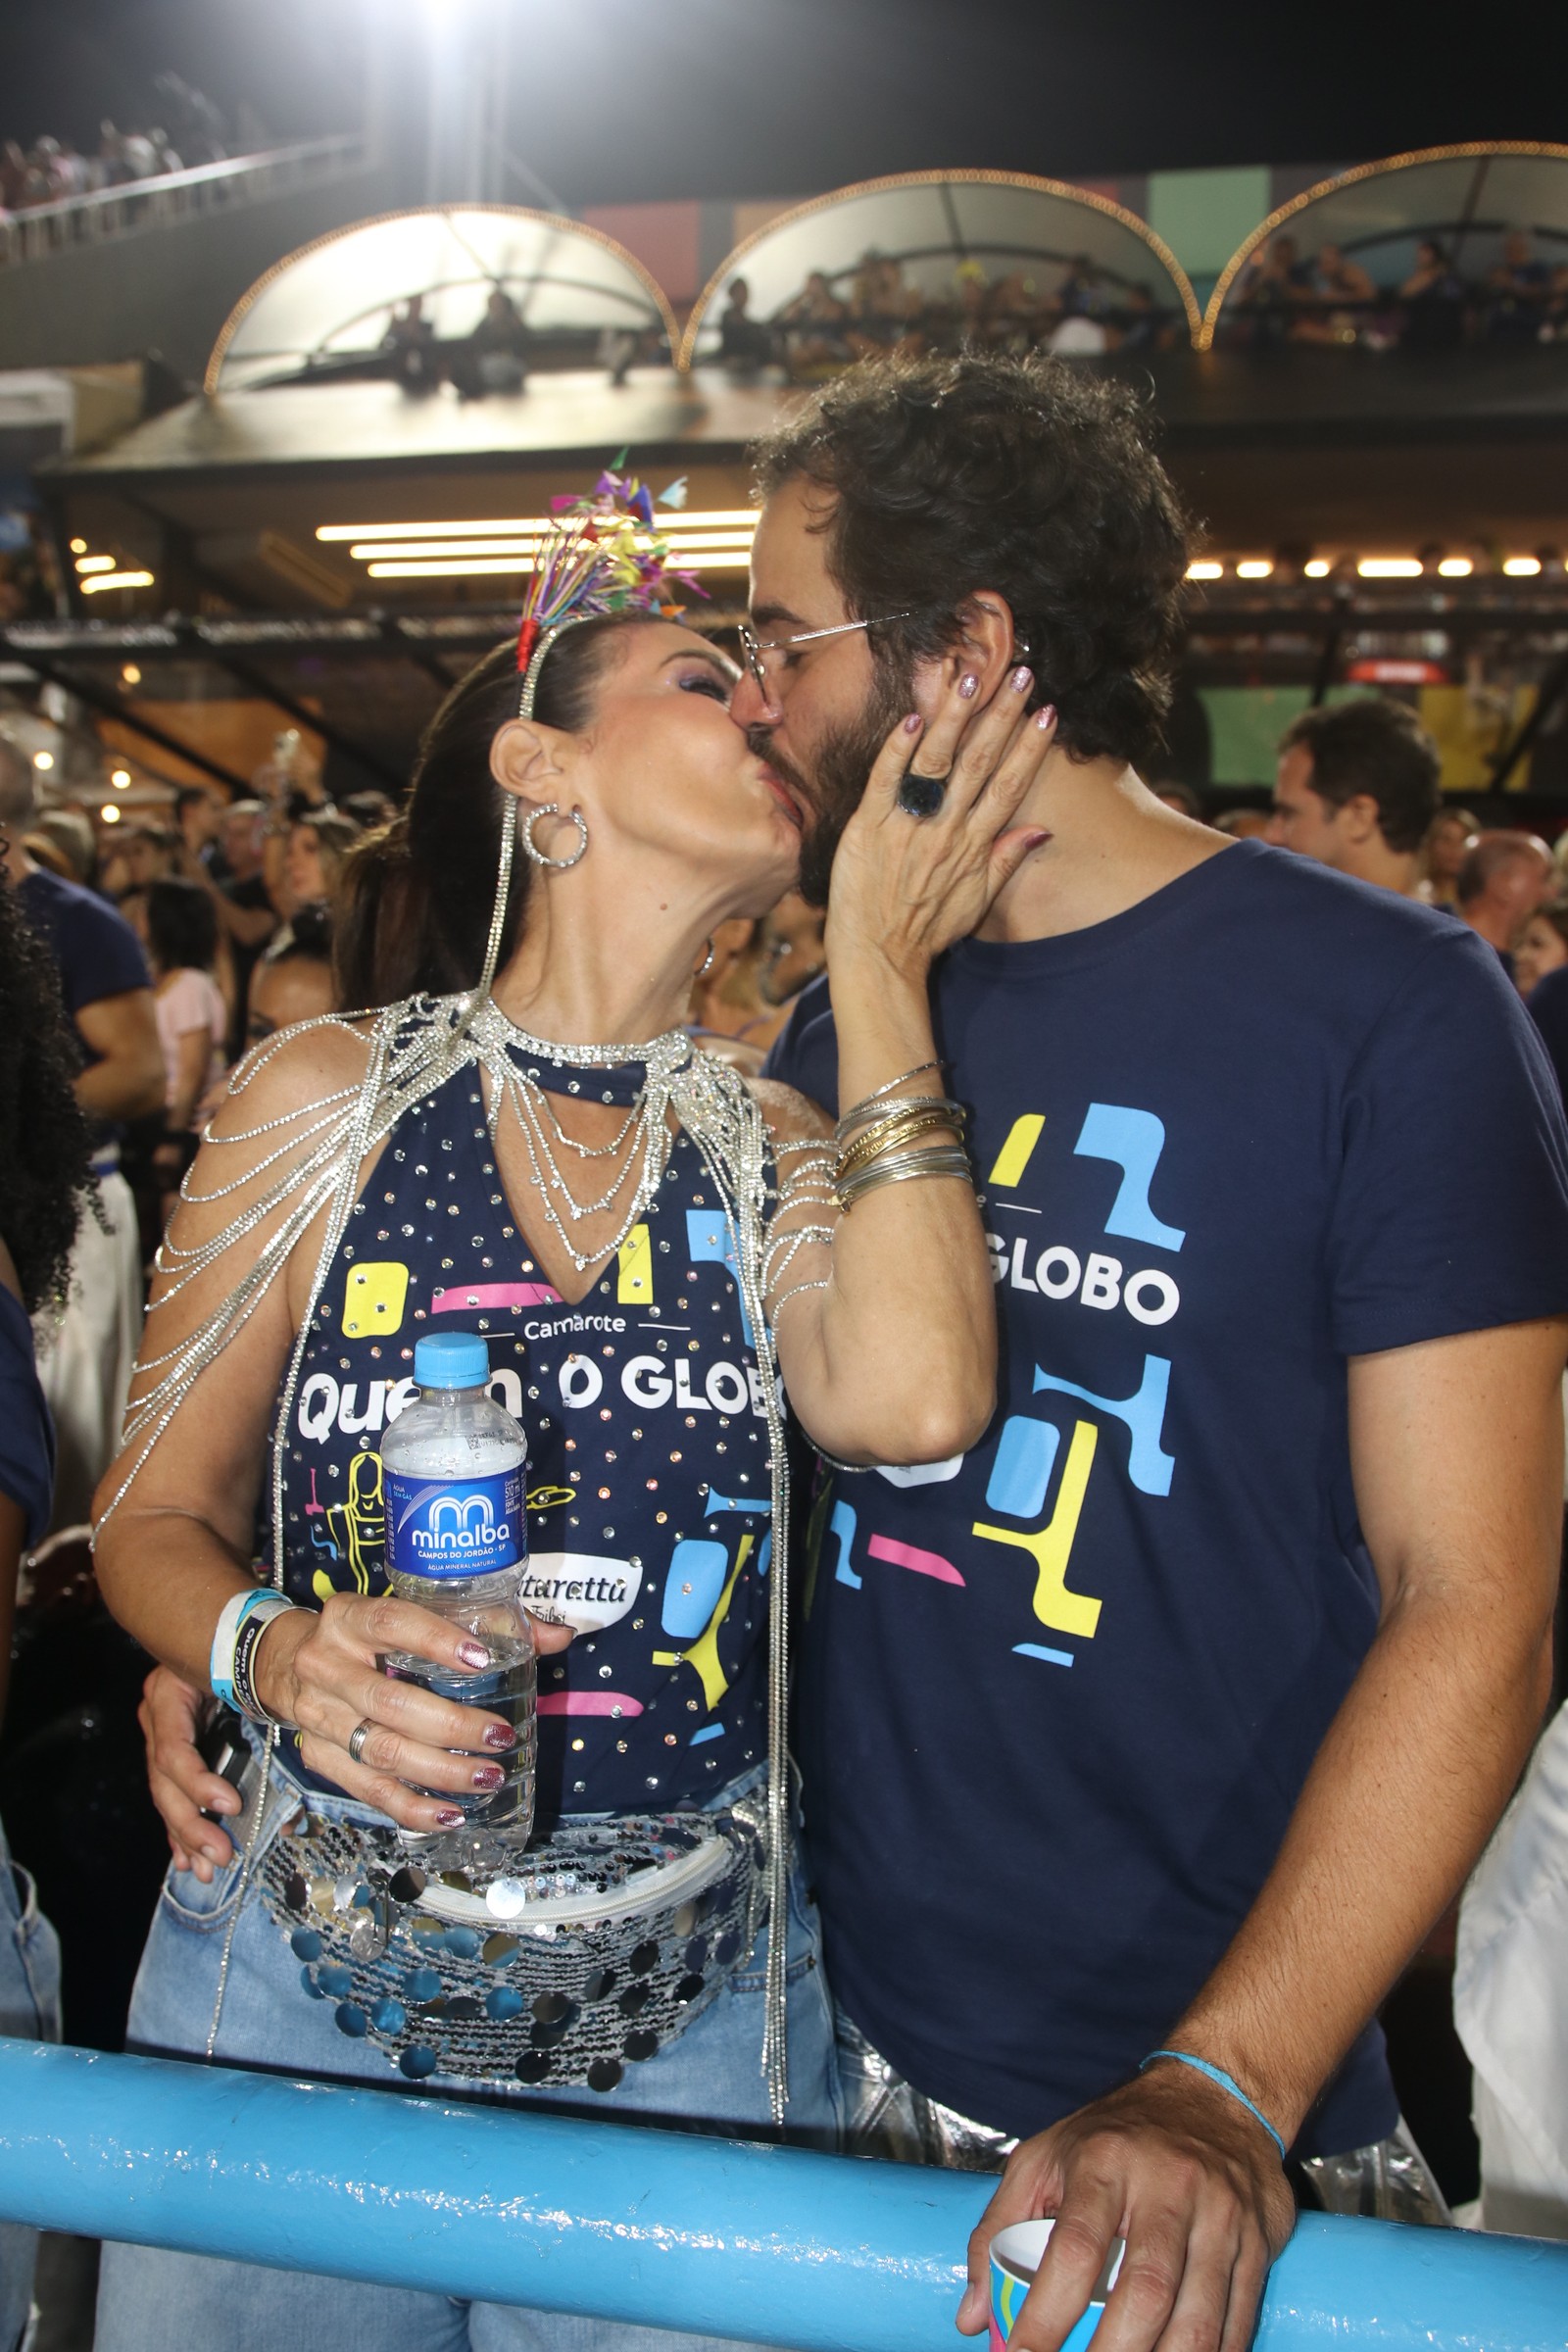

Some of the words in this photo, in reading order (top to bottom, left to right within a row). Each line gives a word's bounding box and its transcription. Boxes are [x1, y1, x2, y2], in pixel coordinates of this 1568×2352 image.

[523, 1314, 627, 1341] Camarote
[559, 1354, 604, 1409] O
[412, 1524, 511, 1549] minalba
[417, 1550, 448, 1559] CAMPOS
[463, 1546, 494, 1558] JORDÃO
[427, 1562, 444, 1571] ÁGUA
[471, 1558, 497, 1568] NATURAL
[240, 1627, 255, 1674] Quem
